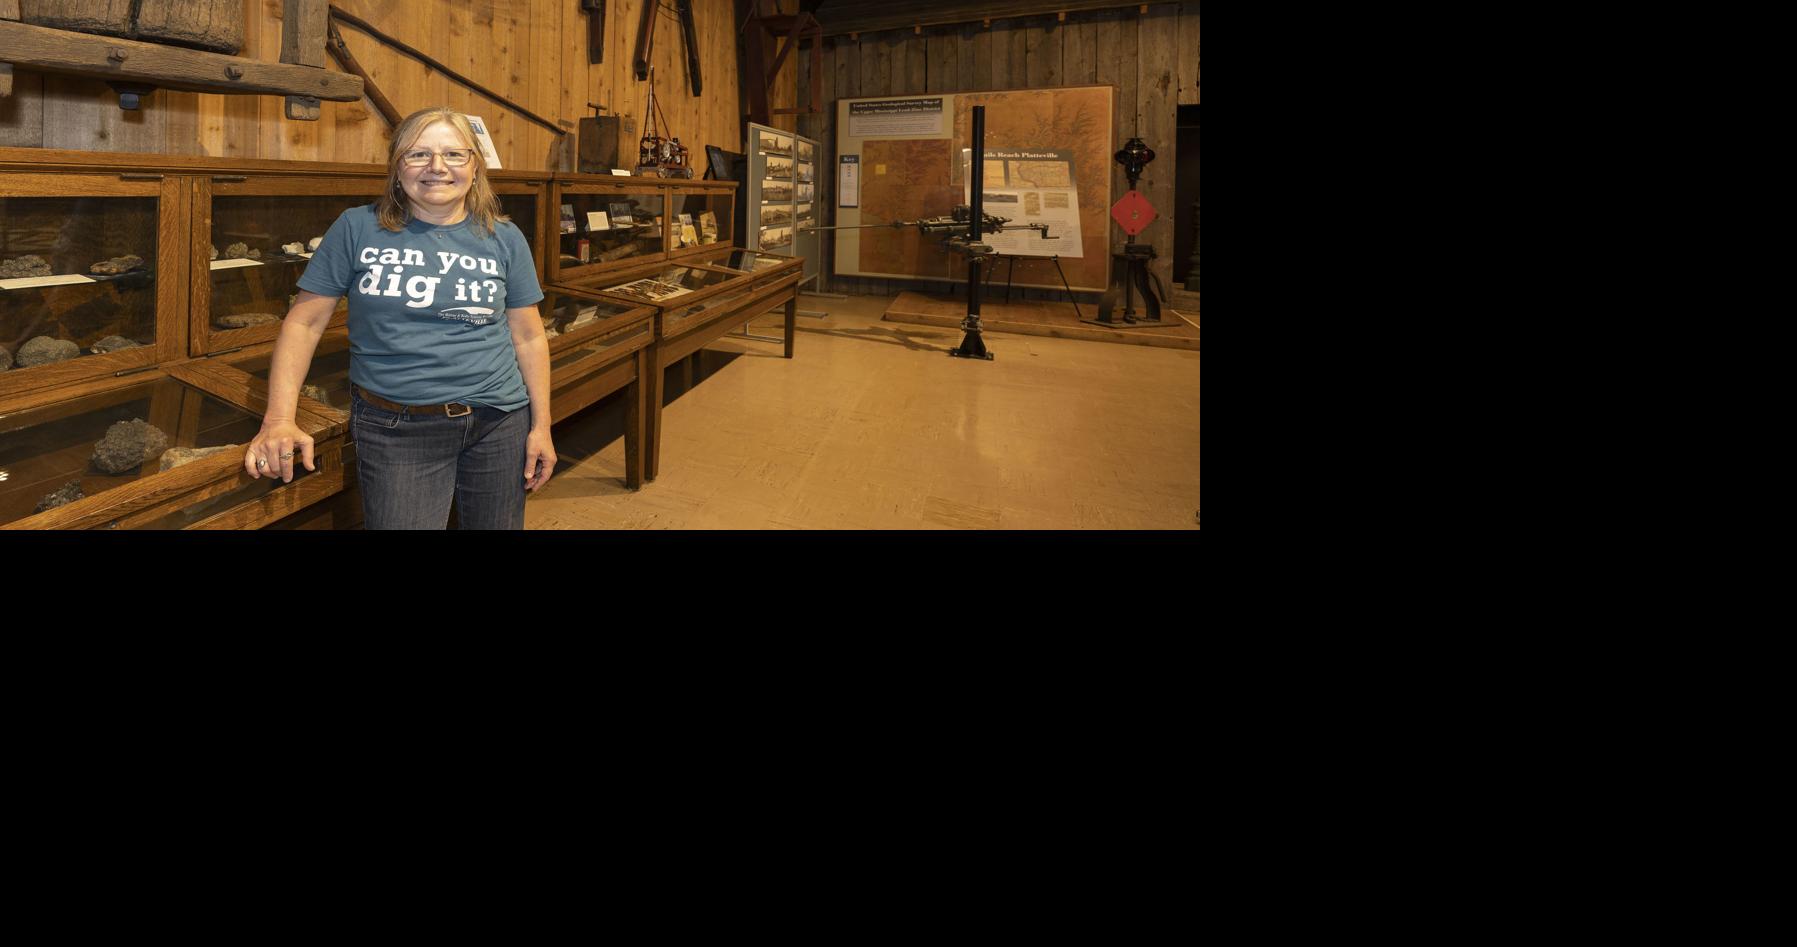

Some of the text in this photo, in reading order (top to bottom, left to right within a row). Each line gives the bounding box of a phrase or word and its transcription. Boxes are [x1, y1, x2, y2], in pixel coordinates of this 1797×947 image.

[360, 247, 499, 276] can you
[358, 264, 498, 308] dig it?
